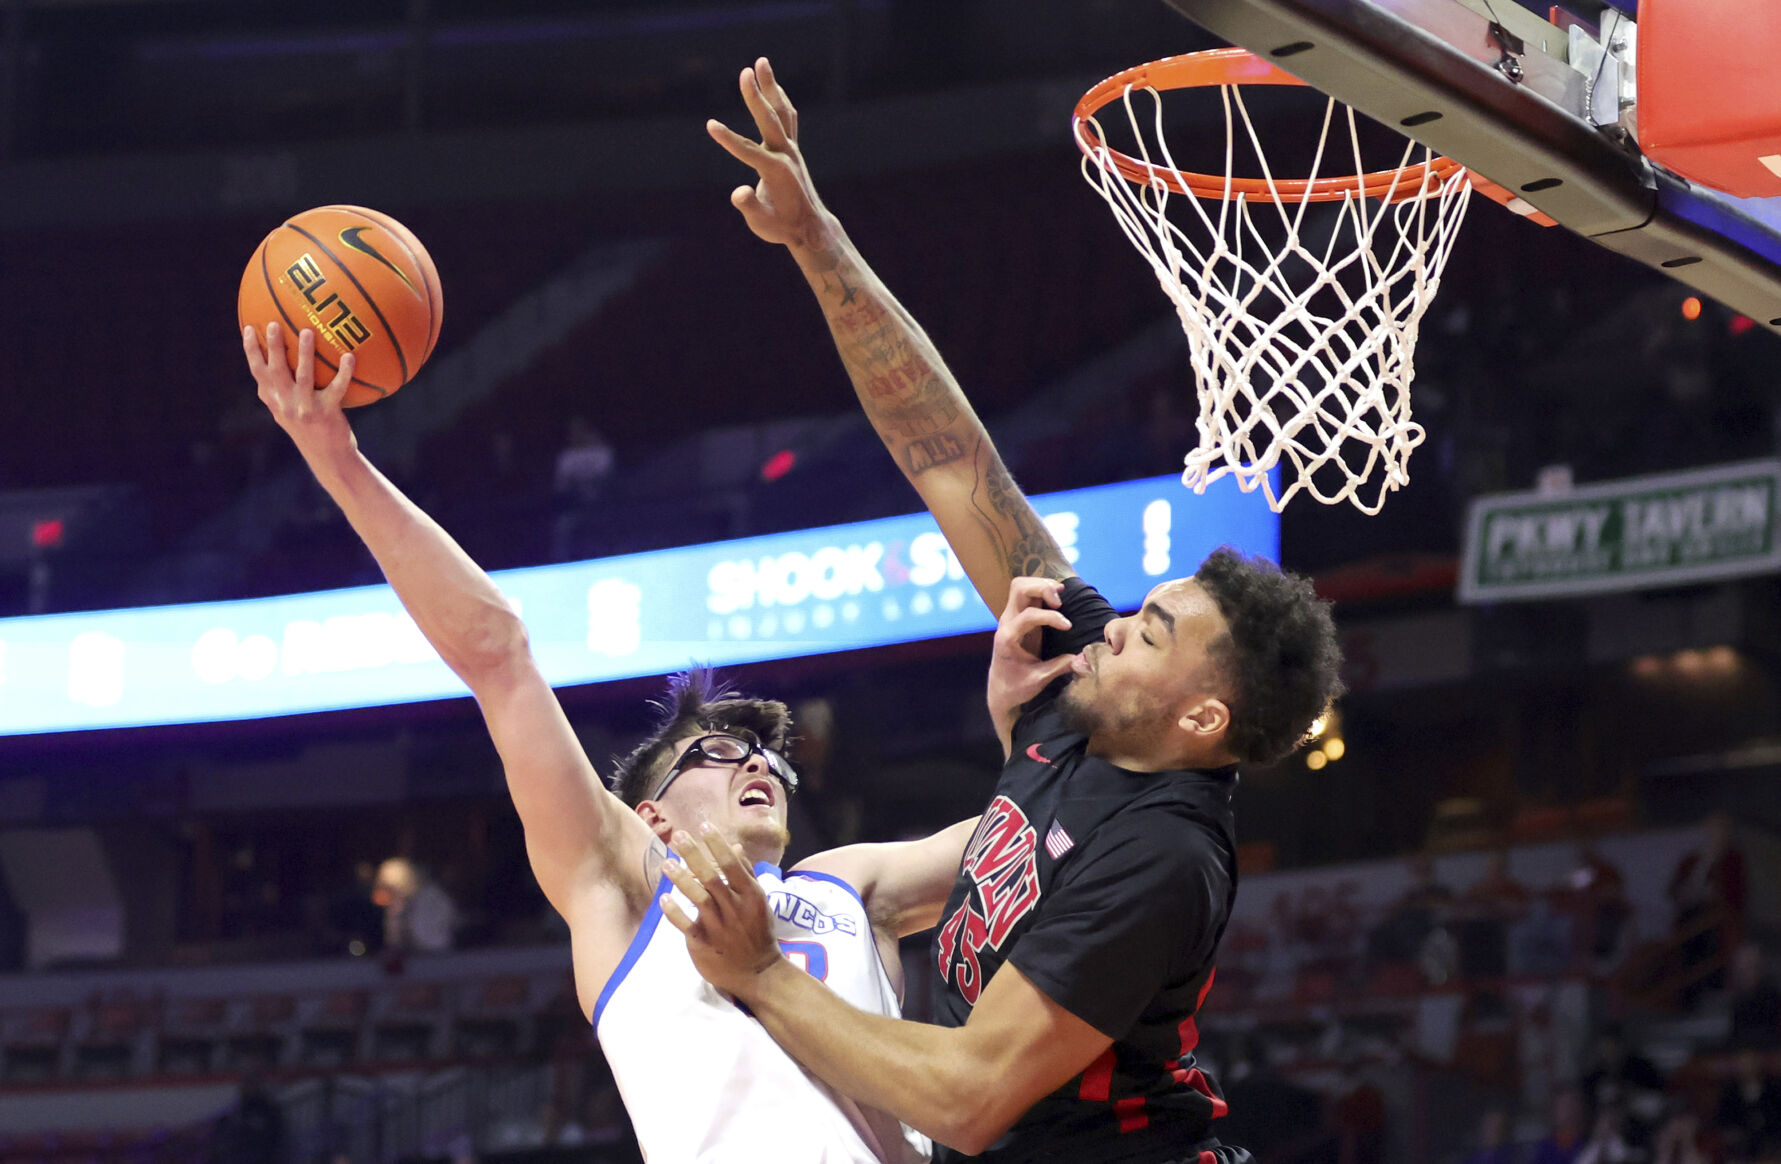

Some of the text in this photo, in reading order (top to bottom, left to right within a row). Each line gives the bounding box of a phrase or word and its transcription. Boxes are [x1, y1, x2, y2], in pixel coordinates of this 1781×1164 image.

[286, 253, 372, 351] ELITE
[1489, 507, 1611, 560] PKWY
[706, 542, 884, 614] SHOOK
[767, 891, 857, 936] NCOS
[963, 795, 1041, 952] UNLV
[938, 891, 988, 1006] 45
